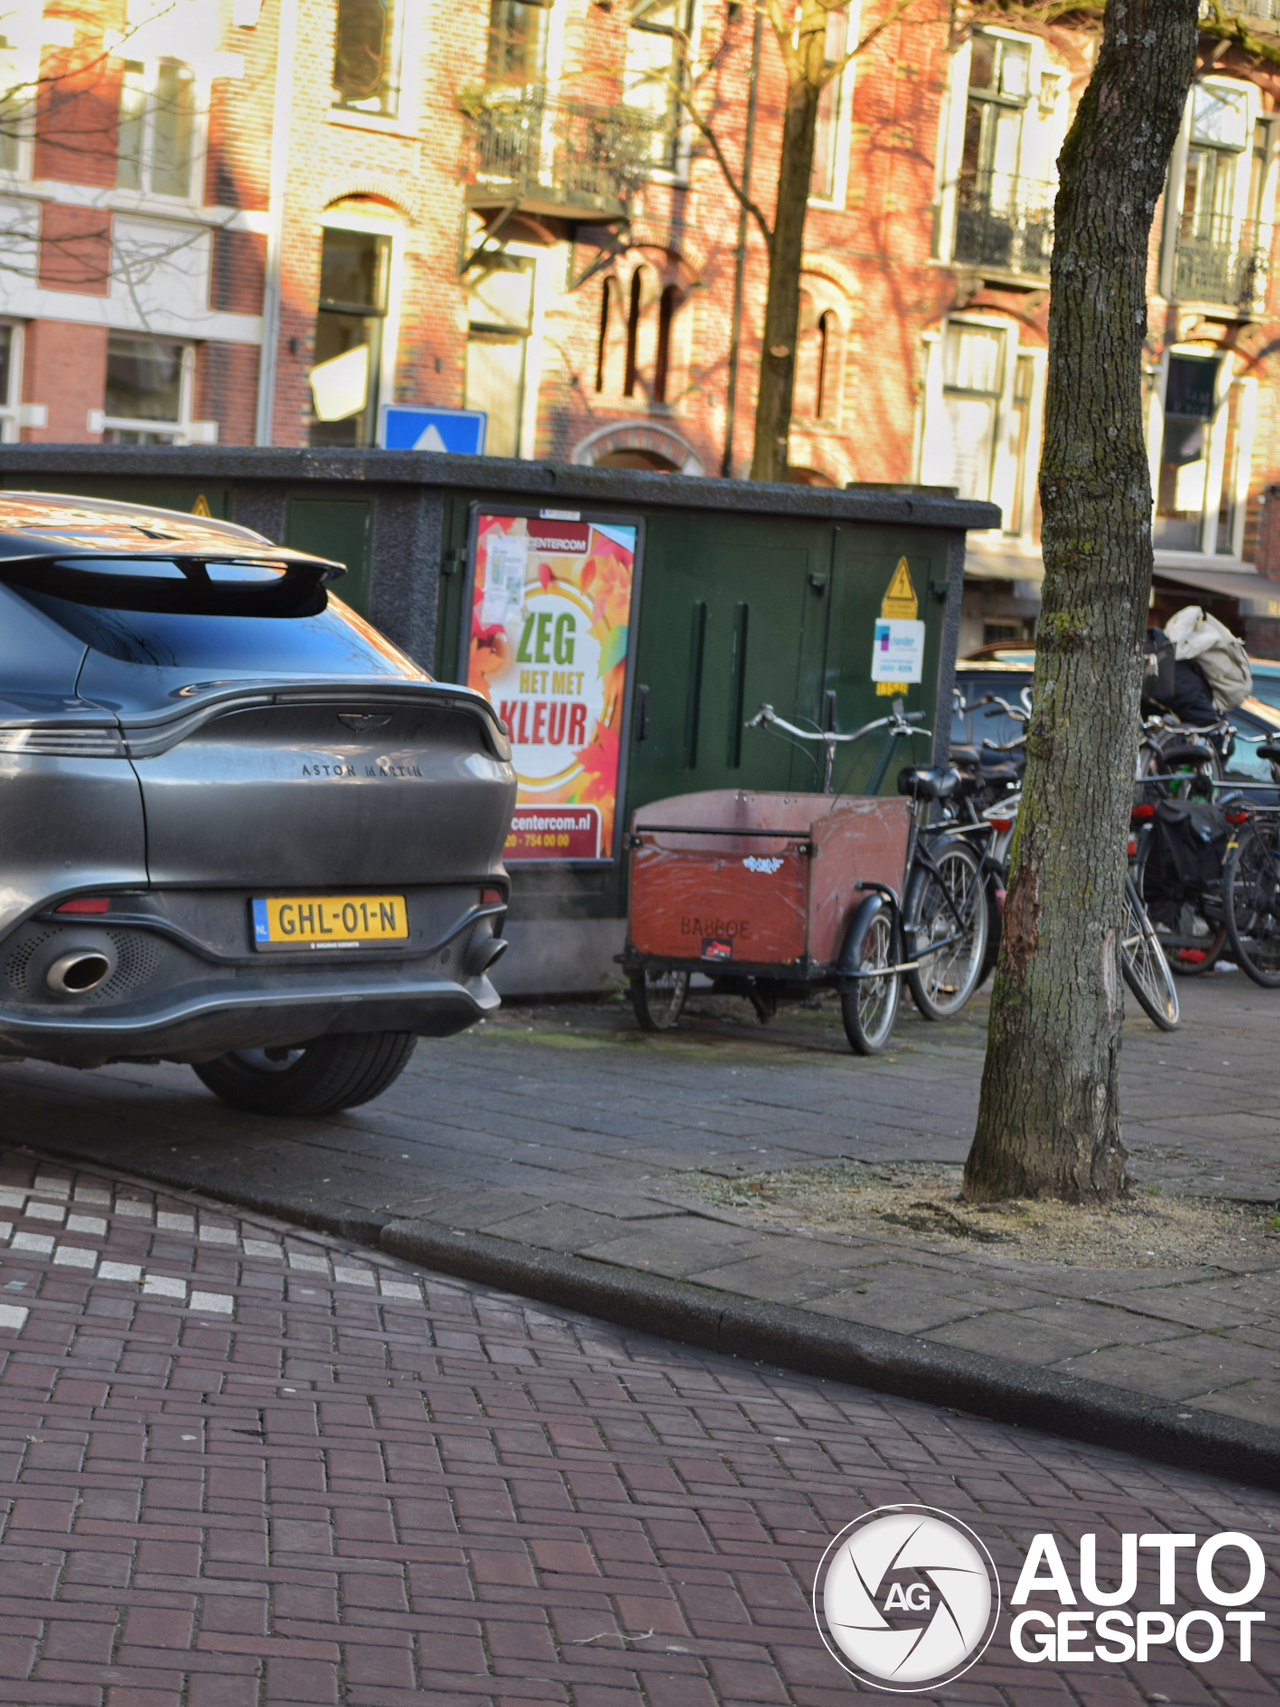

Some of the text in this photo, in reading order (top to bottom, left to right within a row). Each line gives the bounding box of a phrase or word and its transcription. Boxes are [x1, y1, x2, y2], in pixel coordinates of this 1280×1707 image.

[516, 611, 576, 665] ZEG
[519, 670, 585, 695] HET MET
[500, 701, 588, 746] KLEUR
[302, 765, 423, 777] ASTON MARTIN
[524, 833, 542, 847] 754
[544, 833, 556, 847] 00
[557, 833, 570, 847] 00
[256, 925, 268, 934] NL
[279, 901, 397, 935] GHL-01-N
[681, 917, 751, 940] BABBOE
